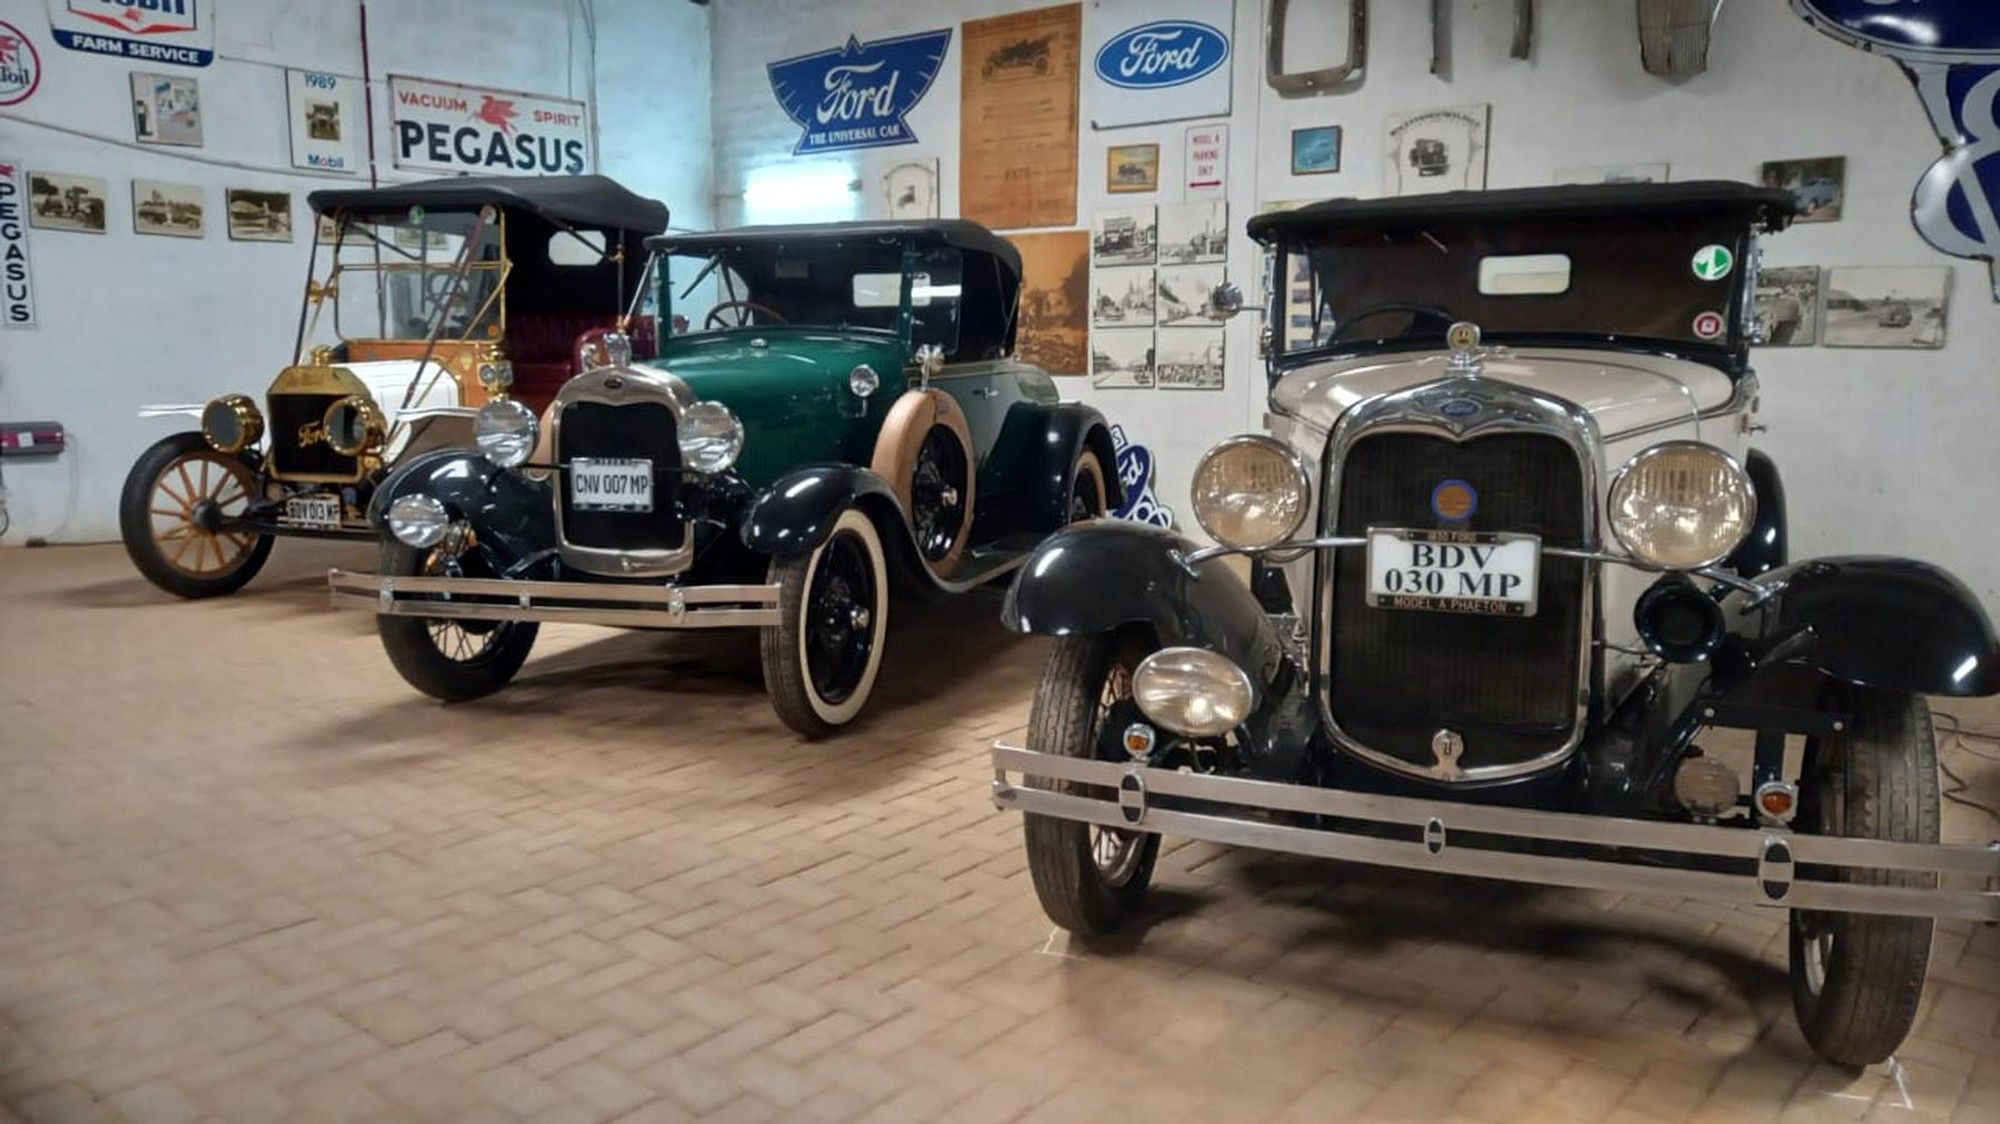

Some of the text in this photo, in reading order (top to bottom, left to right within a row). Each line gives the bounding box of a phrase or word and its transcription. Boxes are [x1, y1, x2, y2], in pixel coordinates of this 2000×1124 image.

[72, 35, 200, 64] FARM SERVICE
[1120, 30, 1203, 77] Ford
[304, 73, 337, 90] 1989
[816, 60, 899, 124] Ford
[398, 90, 582, 127] VACUUM SPIRIT
[395, 120, 585, 175] PEGASUS
[809, 125, 900, 145] THE UNIVERSAL CAR
[307, 153, 344, 169] Mobil
[0, 182, 30, 322] PEGASUS
[576, 474, 649, 495] CNV 007 MP
[1411, 543, 1497, 570] BDV
[1385, 568, 1521, 598] 030 MP
[1394, 597, 1430, 609] MODEL
[1452, 600, 1508, 614] PHAETON
